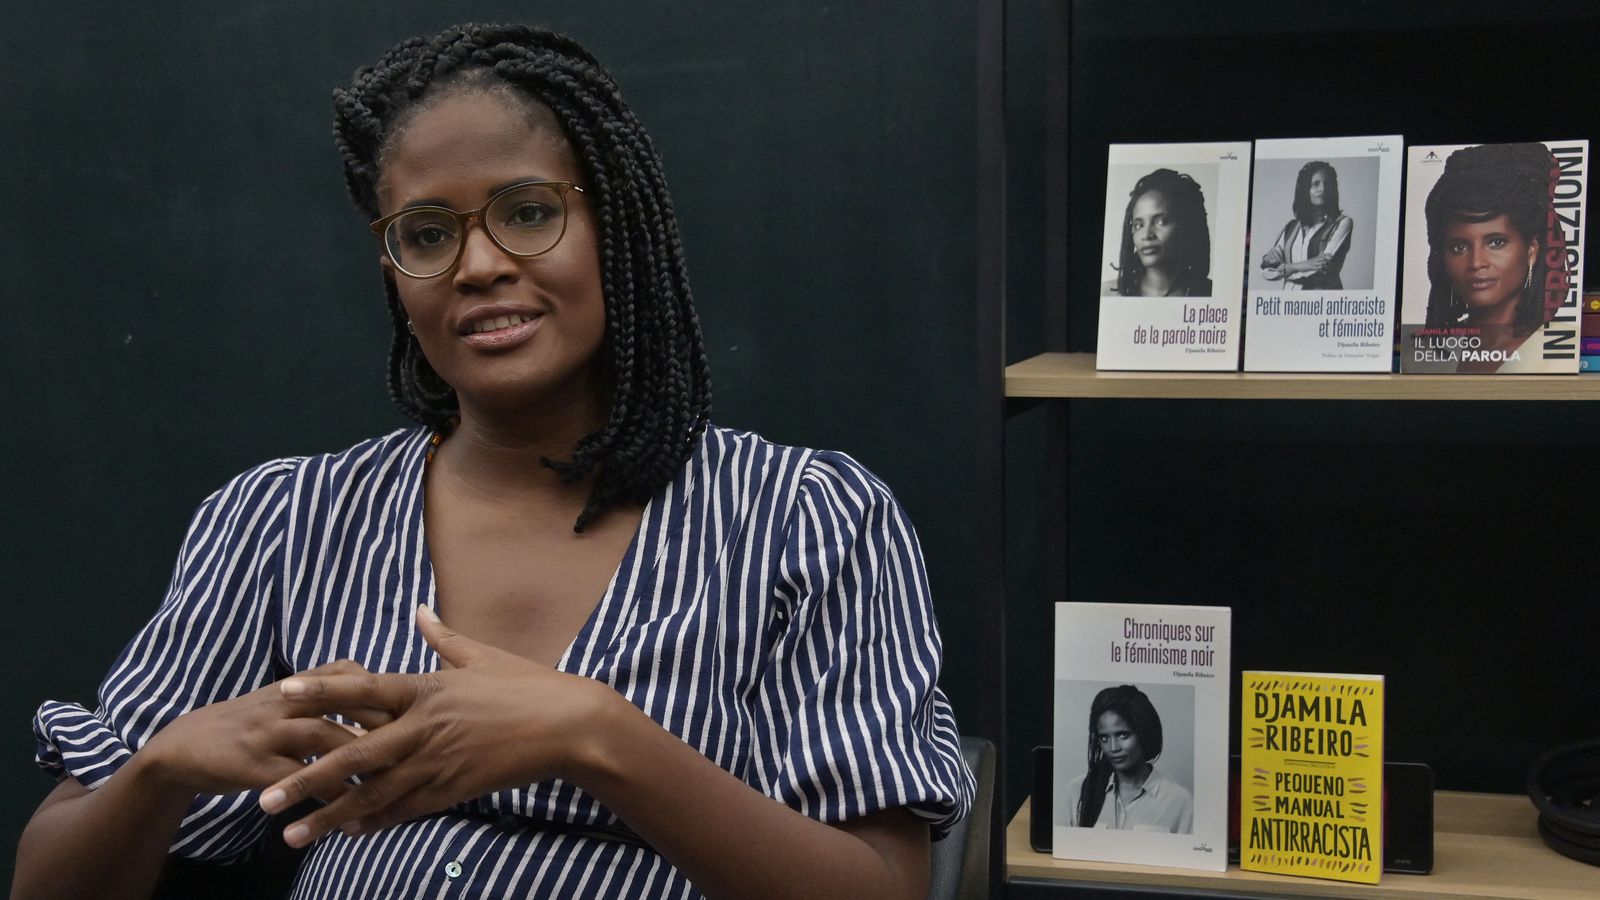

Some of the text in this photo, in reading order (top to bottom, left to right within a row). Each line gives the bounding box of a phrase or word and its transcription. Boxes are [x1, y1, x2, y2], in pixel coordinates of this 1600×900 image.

[1542, 146, 1584, 360] INTERSEZIONI
[1183, 304, 1228, 326] La place
[1256, 296, 1386, 316] Petit manuel antiraciste
[1133, 325, 1227, 347] de la parole noire
[1319, 318, 1385, 338] et féministe
[1414, 336, 1481, 349] IL LUOGO
[1414, 350, 1521, 362] DELLA PAROLA
[1124, 617, 1215, 643] Chroniques sur
[1111, 641, 1215, 667] le féminisme noir
[1254, 692, 1367, 727] DJAMILA
[1266, 724, 1353, 757] RIBEIRO
[1275, 772, 1345, 797] PEQUENO
[1275, 796, 1345, 819] MANUAL
[1249, 817, 1372, 861] ANTIRRACISTA
